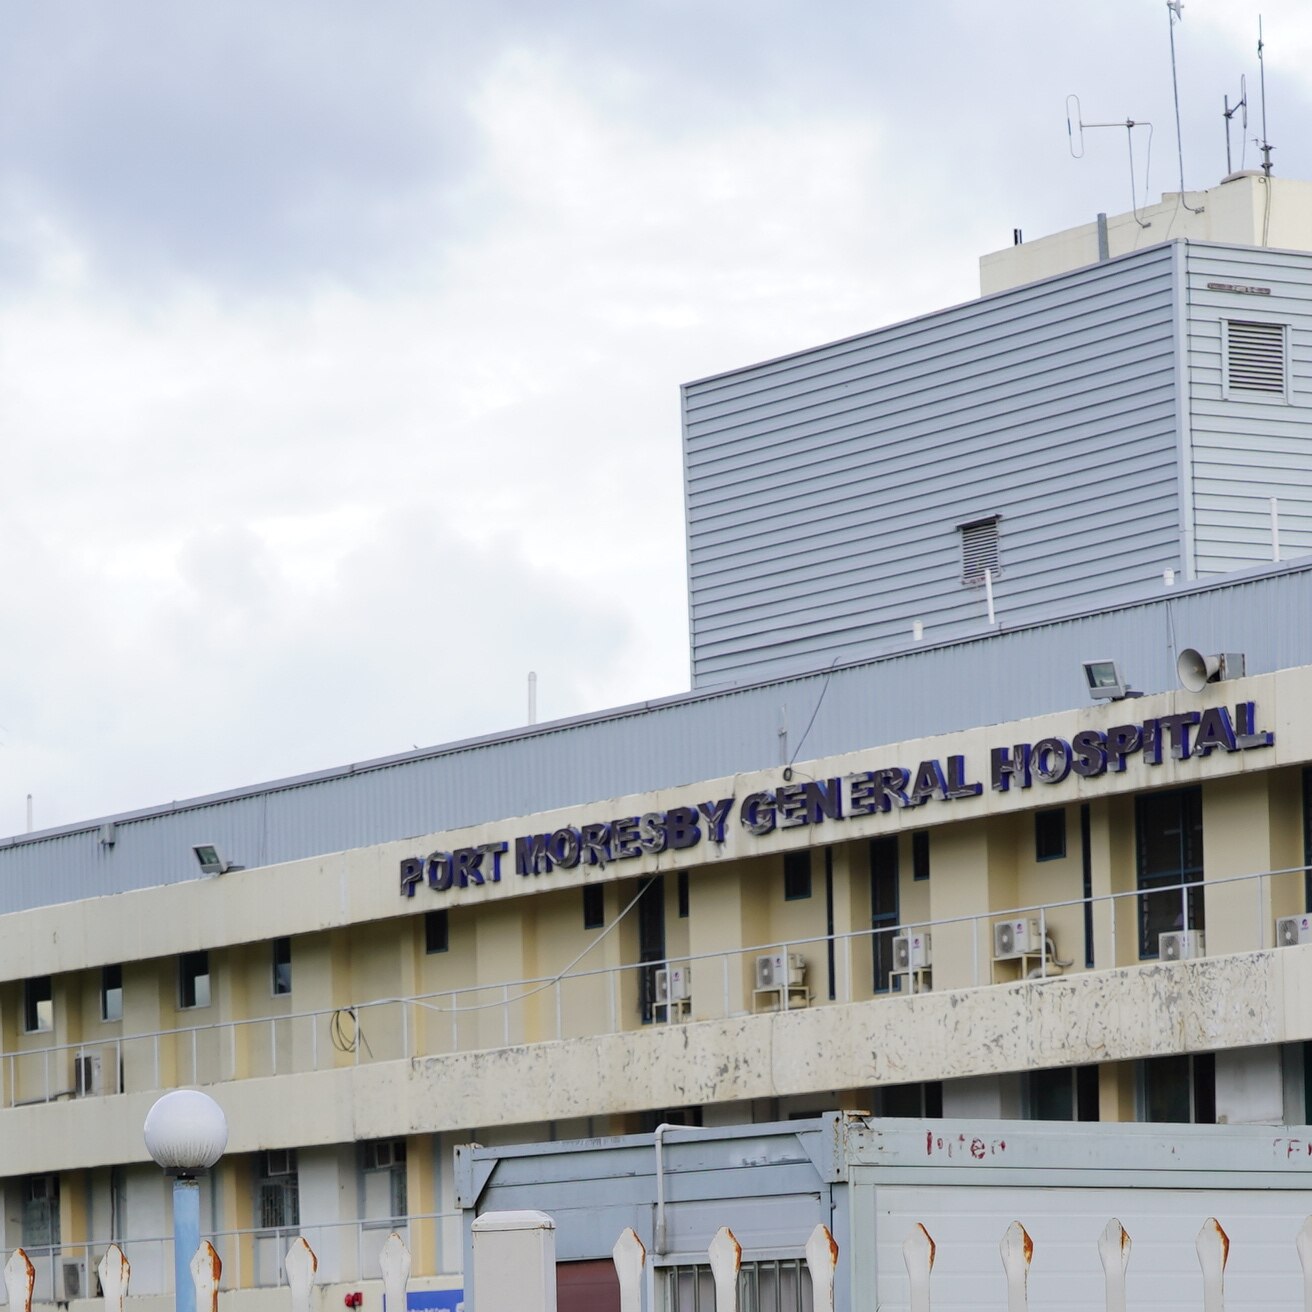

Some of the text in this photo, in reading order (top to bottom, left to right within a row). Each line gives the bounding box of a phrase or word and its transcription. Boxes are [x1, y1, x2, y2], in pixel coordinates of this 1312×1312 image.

[400, 701, 1274, 897] PORT MORESBY GENERAL HOSPITAL
